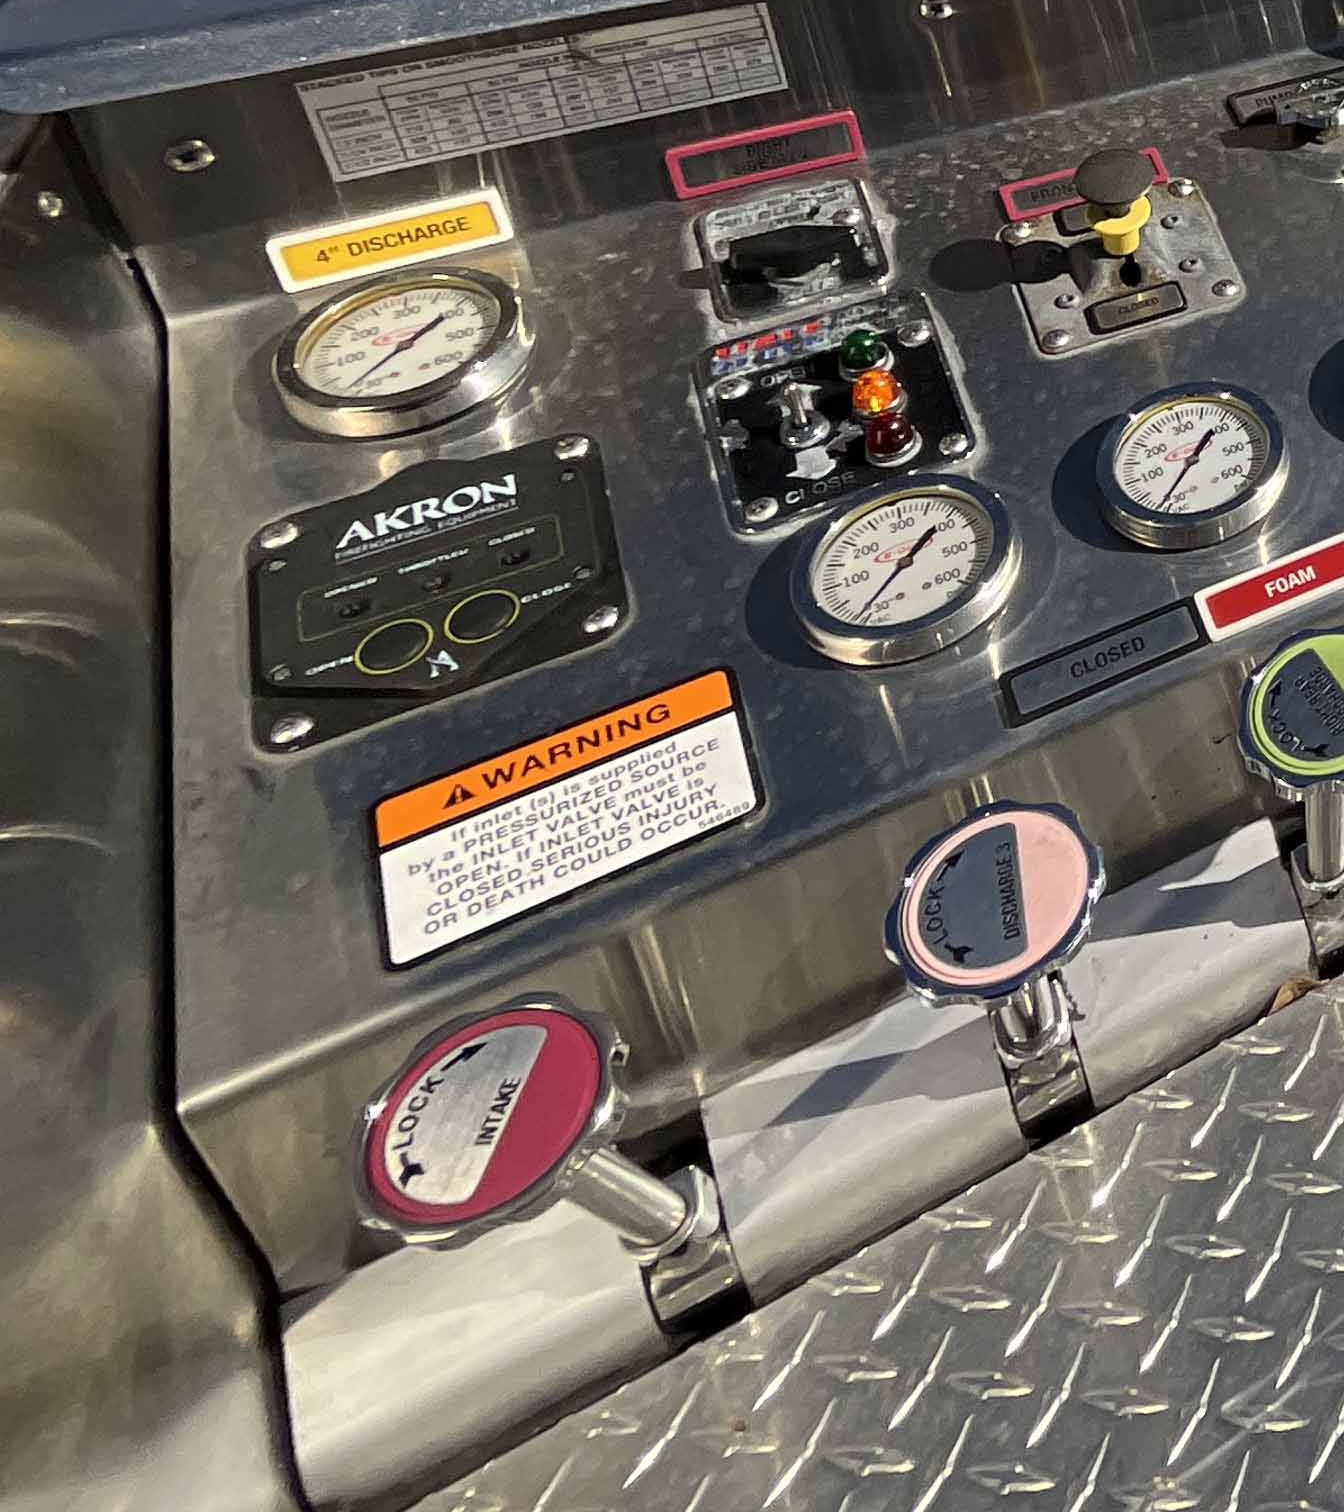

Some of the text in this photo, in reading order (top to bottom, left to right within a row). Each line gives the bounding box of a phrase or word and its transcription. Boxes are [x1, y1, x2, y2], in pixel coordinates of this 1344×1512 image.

[316, 216, 471, 264] 4" DISCHARGE
[393, 304, 421, 320] 300
[445, 327, 475, 342] 500
[337, 351, 365, 367] 100
[433, 351, 464, 366] 600
[1172, 421, 1194, 437] 300
[1144, 443, 1168, 459] 200
[1222, 442, 1245, 456] 500
[1140, 466, 1164, 482] 100
[1221, 465, 1243, 480] 600
[335, 473, 518, 549] AKRON
[889, 516, 915, 535] 300
[852, 541, 880, 560] 200
[941, 541, 968, 558] 500
[842, 570, 870, 589] 100
[933, 568, 961, 585] 600
[1264, 565, 1317, 599] FOAM
[873, 600, 890, 612] 30
[1069, 636, 1145, 678] CLOSED
[1293, 675, 1344, 737] RIGHT REAR
[481, 704, 671, 789] WARNING
[1268, 708, 1304, 752] LOCK
[408, 737, 721, 877] by a PRESSURIZED SOURCE
[451, 740, 677, 842] If inlet (s) is supplied
[429, 760, 708, 883] the INLET VALVE must be
[437, 777, 705, 896] OPEN. If INLET VALVE is
[423, 799, 726, 936] OR DEATH COULD OCCUR.
[426, 783, 718, 917] CLOSED SERIOUS INJURY
[923, 880, 945, 945] LOCK
[995, 857, 1021, 941] DISCHARGE
[392, 1075, 445, 1151] LOCK
[475, 1077, 521, 1146] INTAKE
